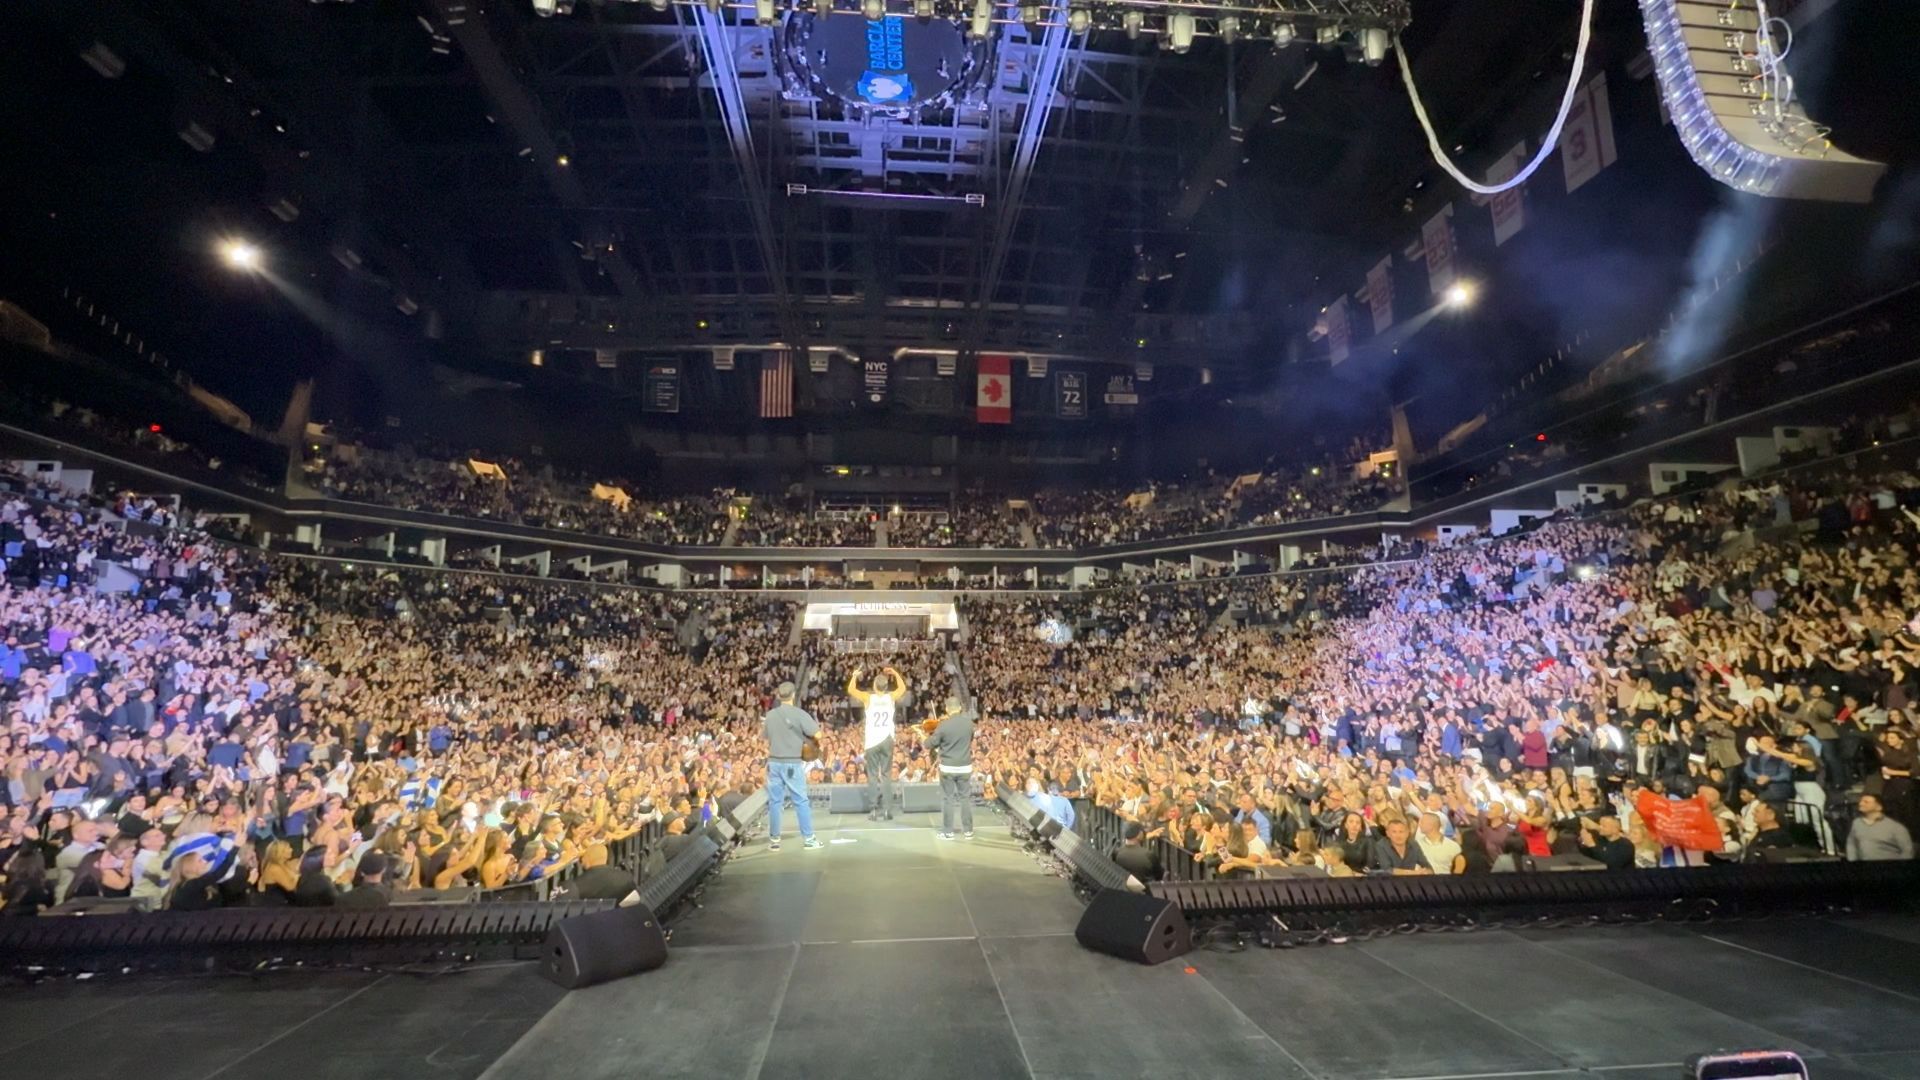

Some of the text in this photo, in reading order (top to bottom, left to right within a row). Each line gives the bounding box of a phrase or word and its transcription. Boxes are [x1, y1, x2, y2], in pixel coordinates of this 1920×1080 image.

[867, 20, 885, 69] BARCLA
[865, 362, 888, 371] NYC
[1107, 376, 1125, 385] JAY
[1063, 391, 1081, 404] 72
[873, 711, 889, 727] 22
